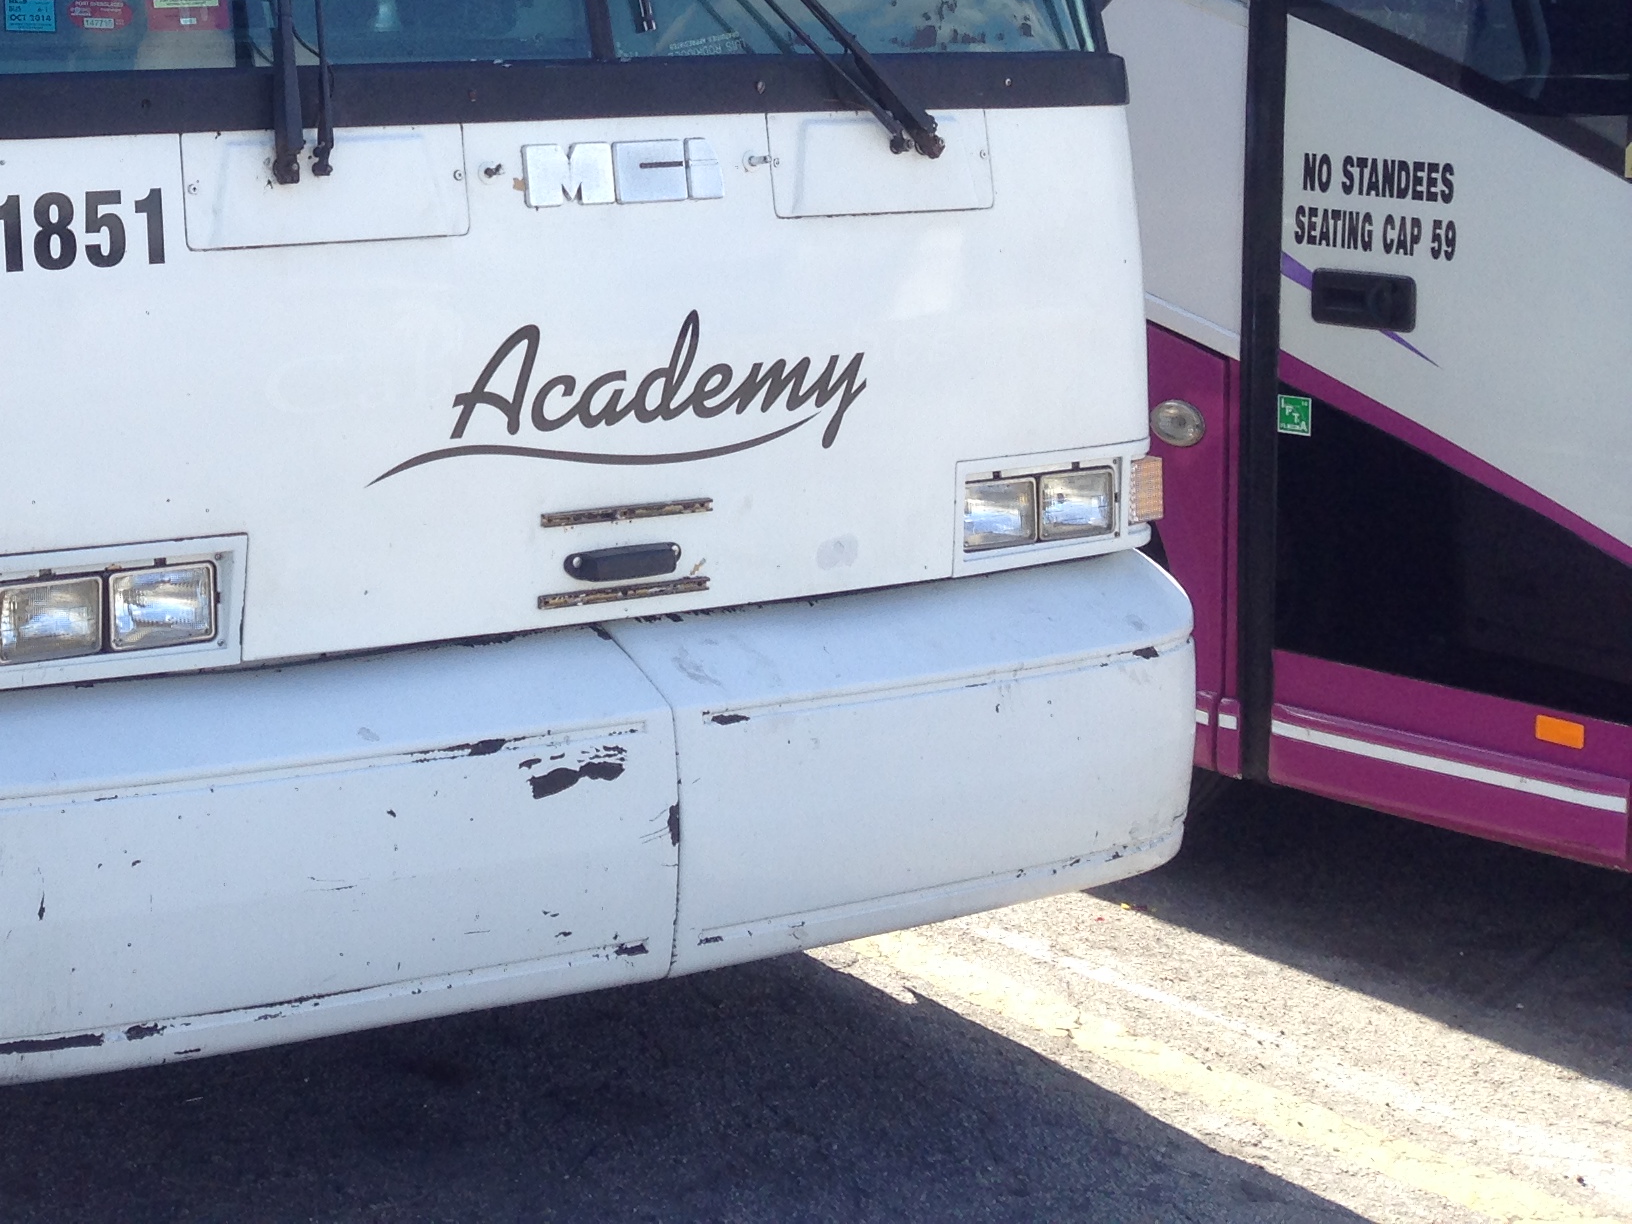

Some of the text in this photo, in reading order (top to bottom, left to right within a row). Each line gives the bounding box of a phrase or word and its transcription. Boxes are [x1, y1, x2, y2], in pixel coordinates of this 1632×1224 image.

[9, 13, 52, 22] OCT 2014
[1303, 152, 1455, 204] NO STANDEES
[1294, 205, 1457, 262] SEATING CAP 59
[449, 309, 868, 450] Academy
